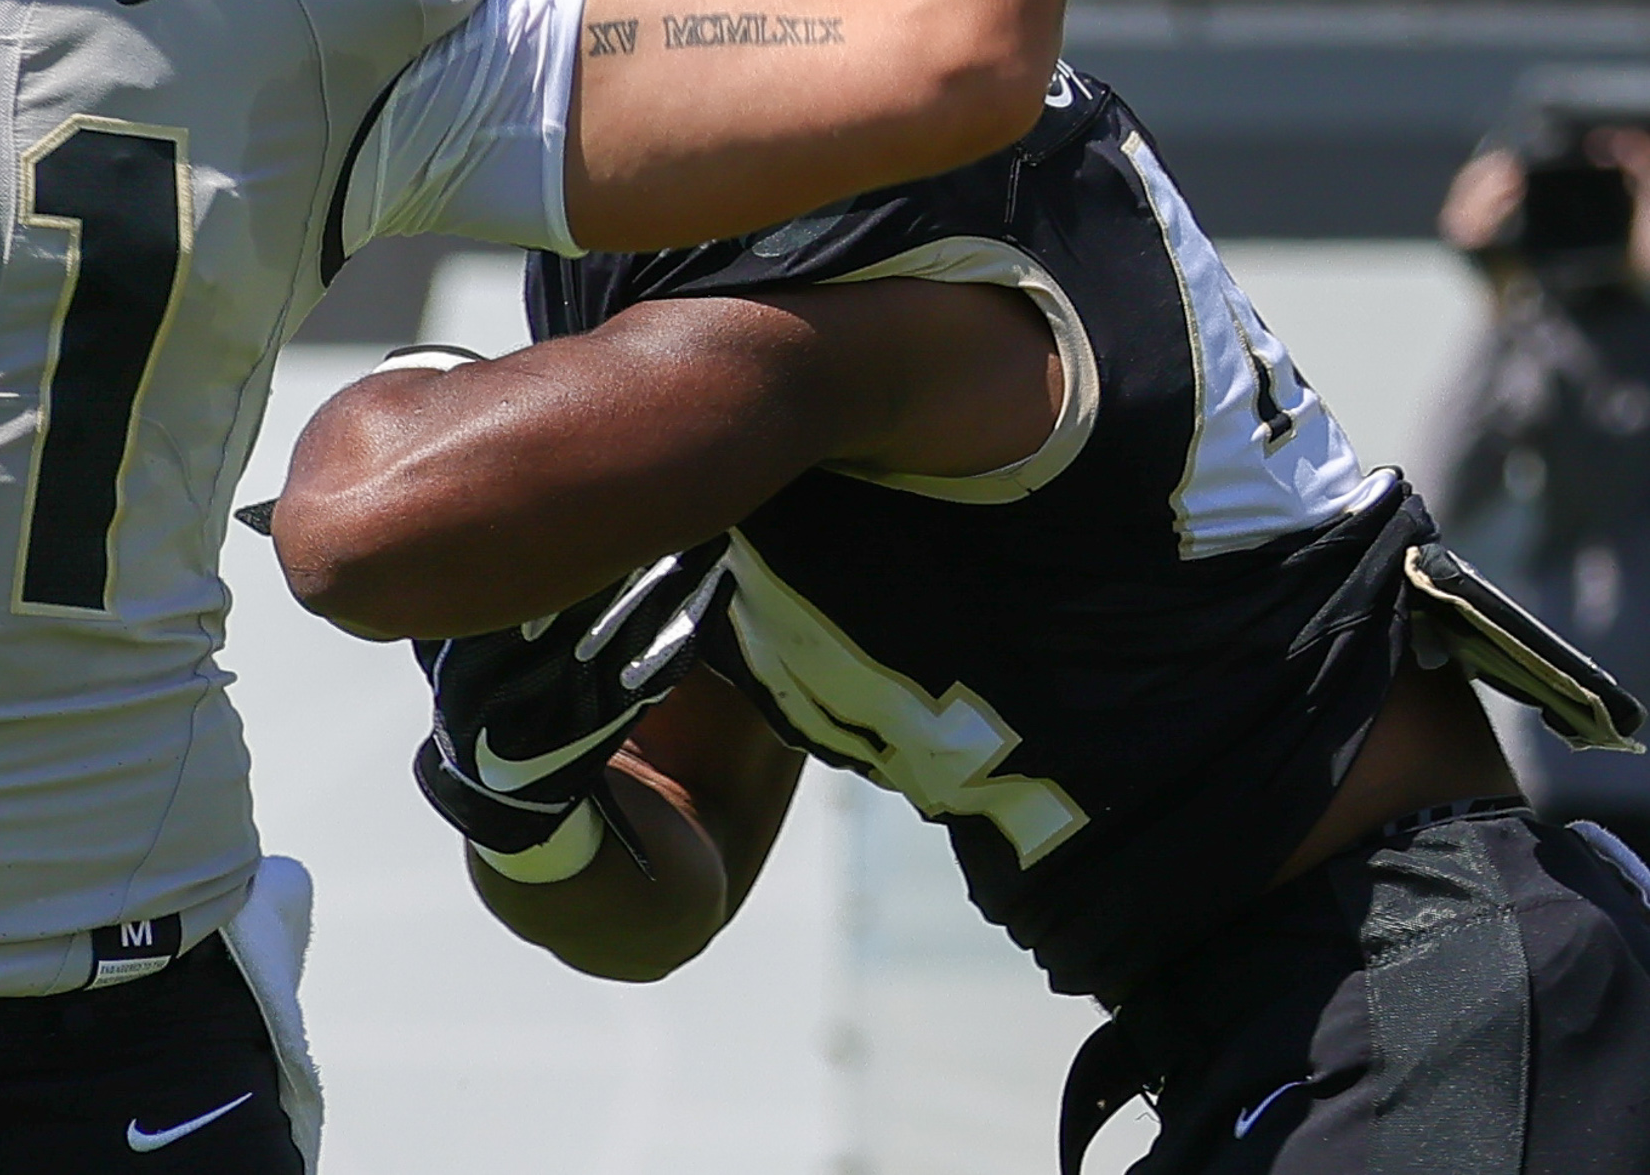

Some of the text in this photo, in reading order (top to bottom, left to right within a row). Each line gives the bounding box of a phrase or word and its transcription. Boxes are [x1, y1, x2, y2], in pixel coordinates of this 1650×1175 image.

[588, 12, 846, 57] XV MCMLXIX
[121, 919, 153, 947] M
